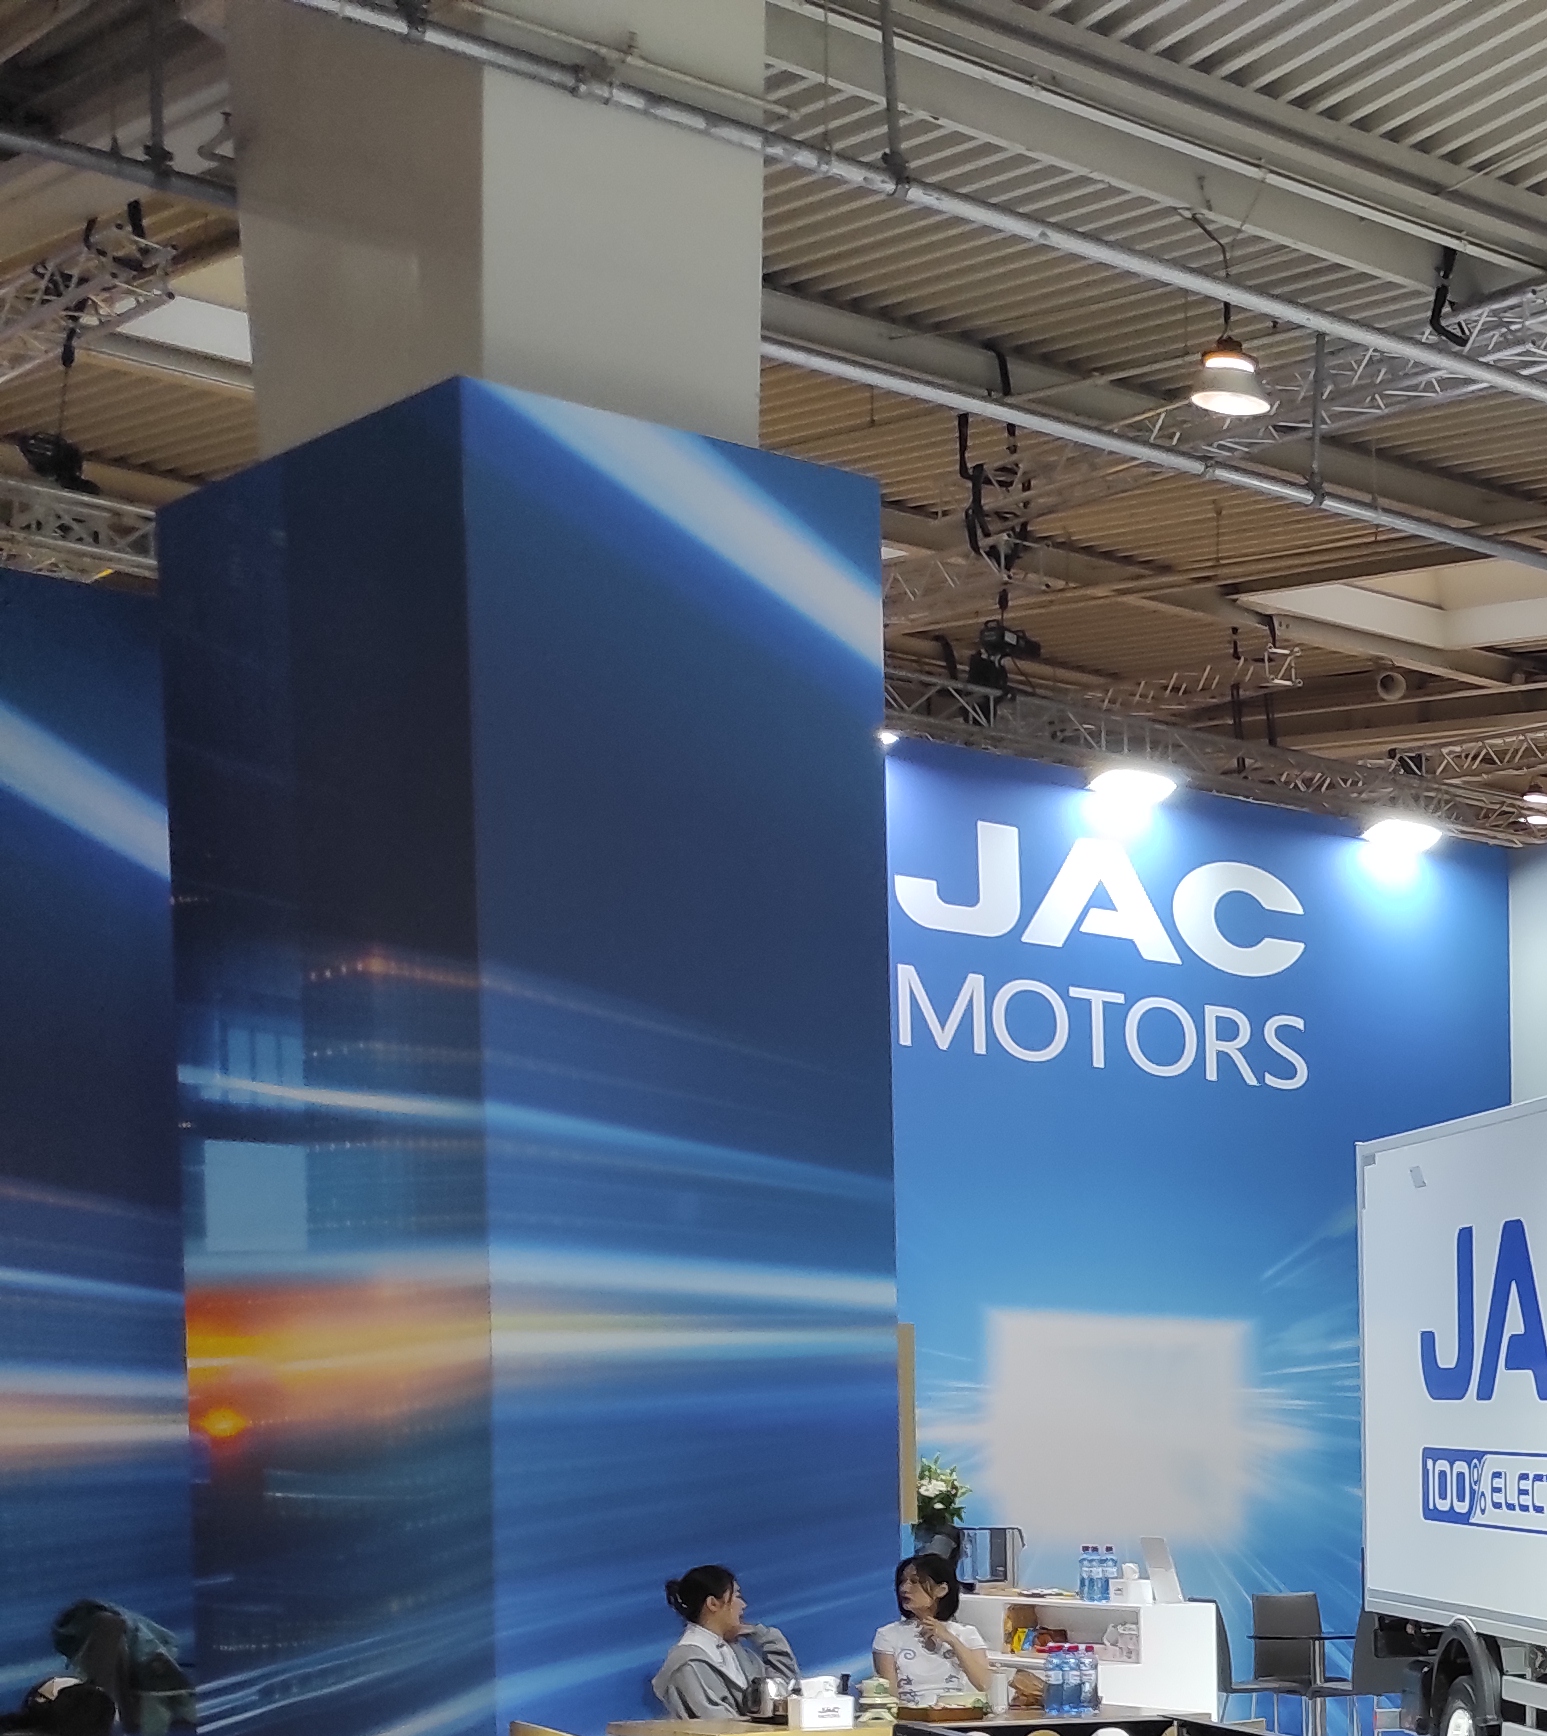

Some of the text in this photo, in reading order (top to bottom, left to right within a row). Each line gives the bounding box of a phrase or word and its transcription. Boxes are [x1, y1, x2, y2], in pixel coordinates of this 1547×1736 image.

[894, 819, 1306, 978] JAC
[896, 963, 1310, 1091] MOTORS
[1425, 1456, 1488, 1521] 100%
